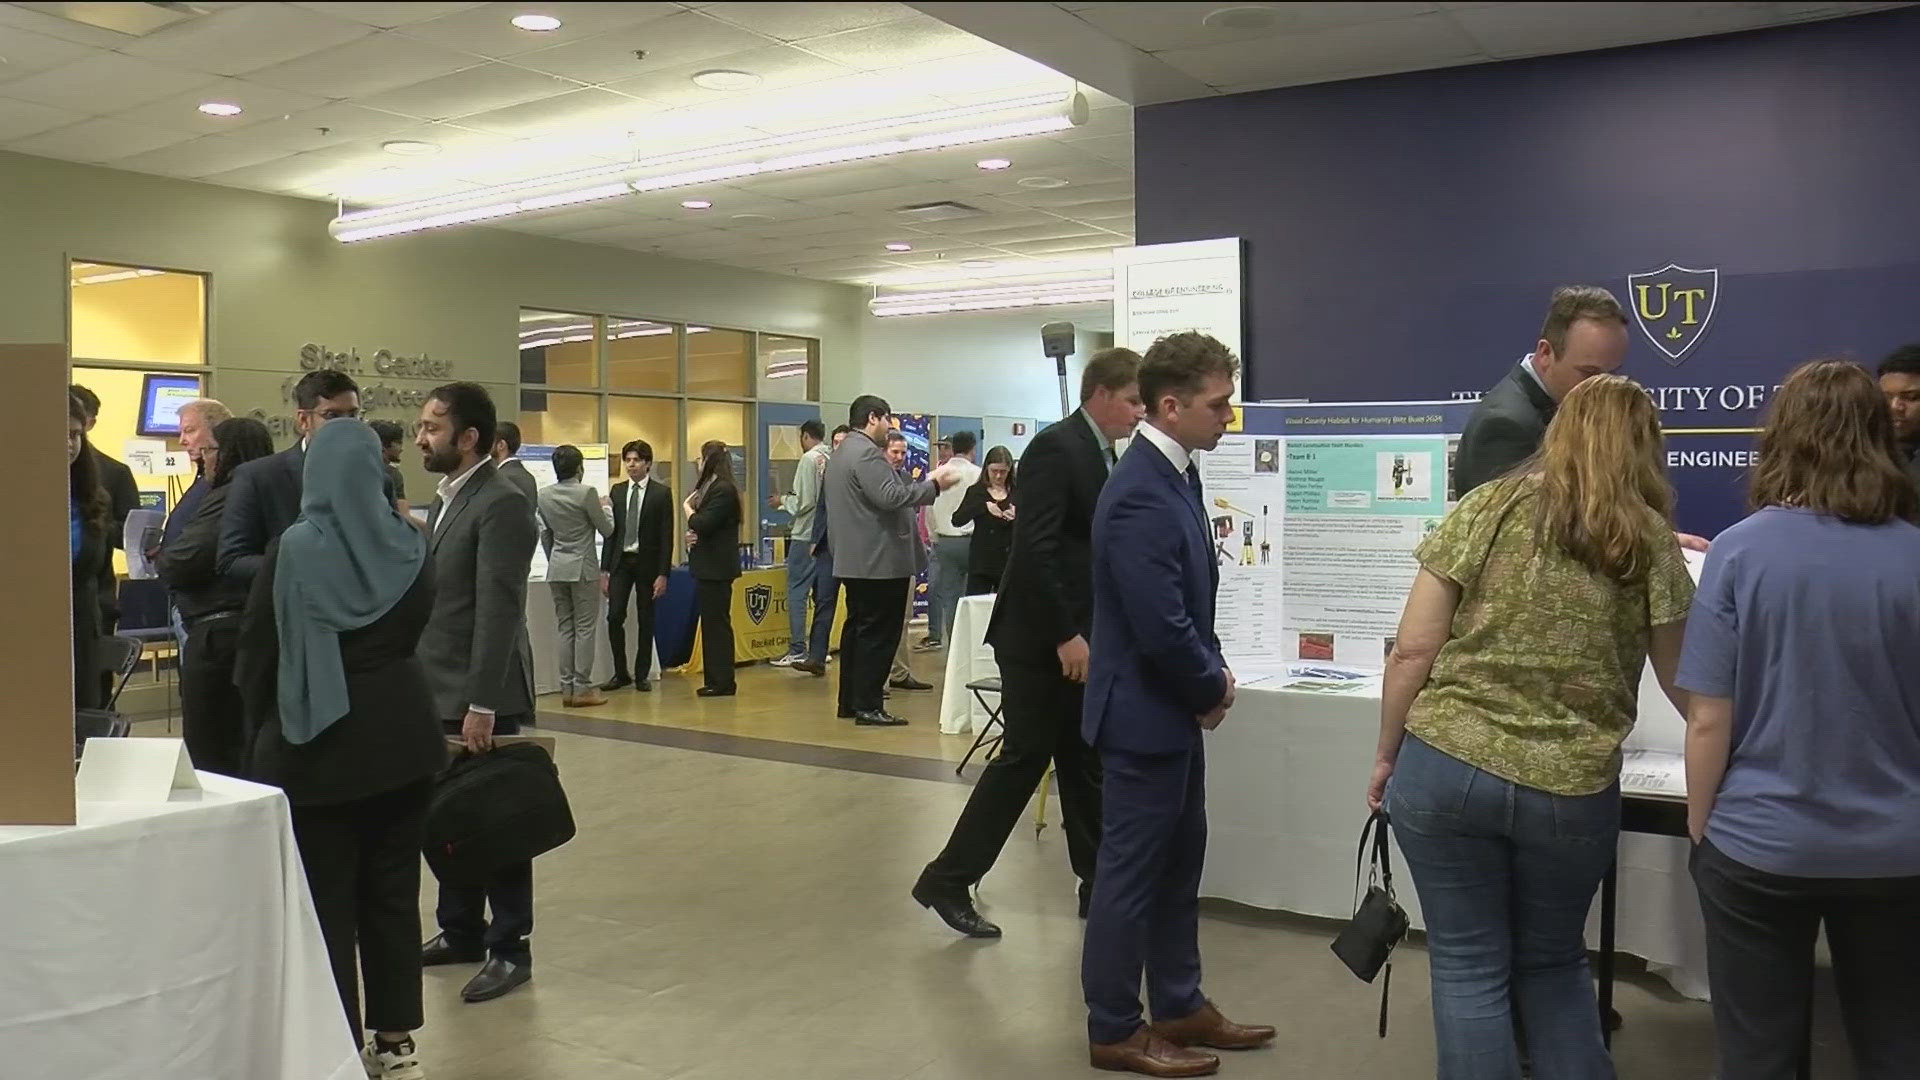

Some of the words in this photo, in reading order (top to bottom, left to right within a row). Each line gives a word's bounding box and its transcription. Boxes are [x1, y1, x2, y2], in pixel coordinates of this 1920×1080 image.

[1635, 283, 1705, 325] UT
[300, 343, 364, 374] Shah
[374, 349, 453, 378] Center
[1719, 385, 1765, 411] OF
[1361, 416, 1392, 425] Humanity
[1667, 450, 1761, 467] ENGINEE
[748, 593, 768, 611] UT
[751, 637, 775, 649] Rocket
